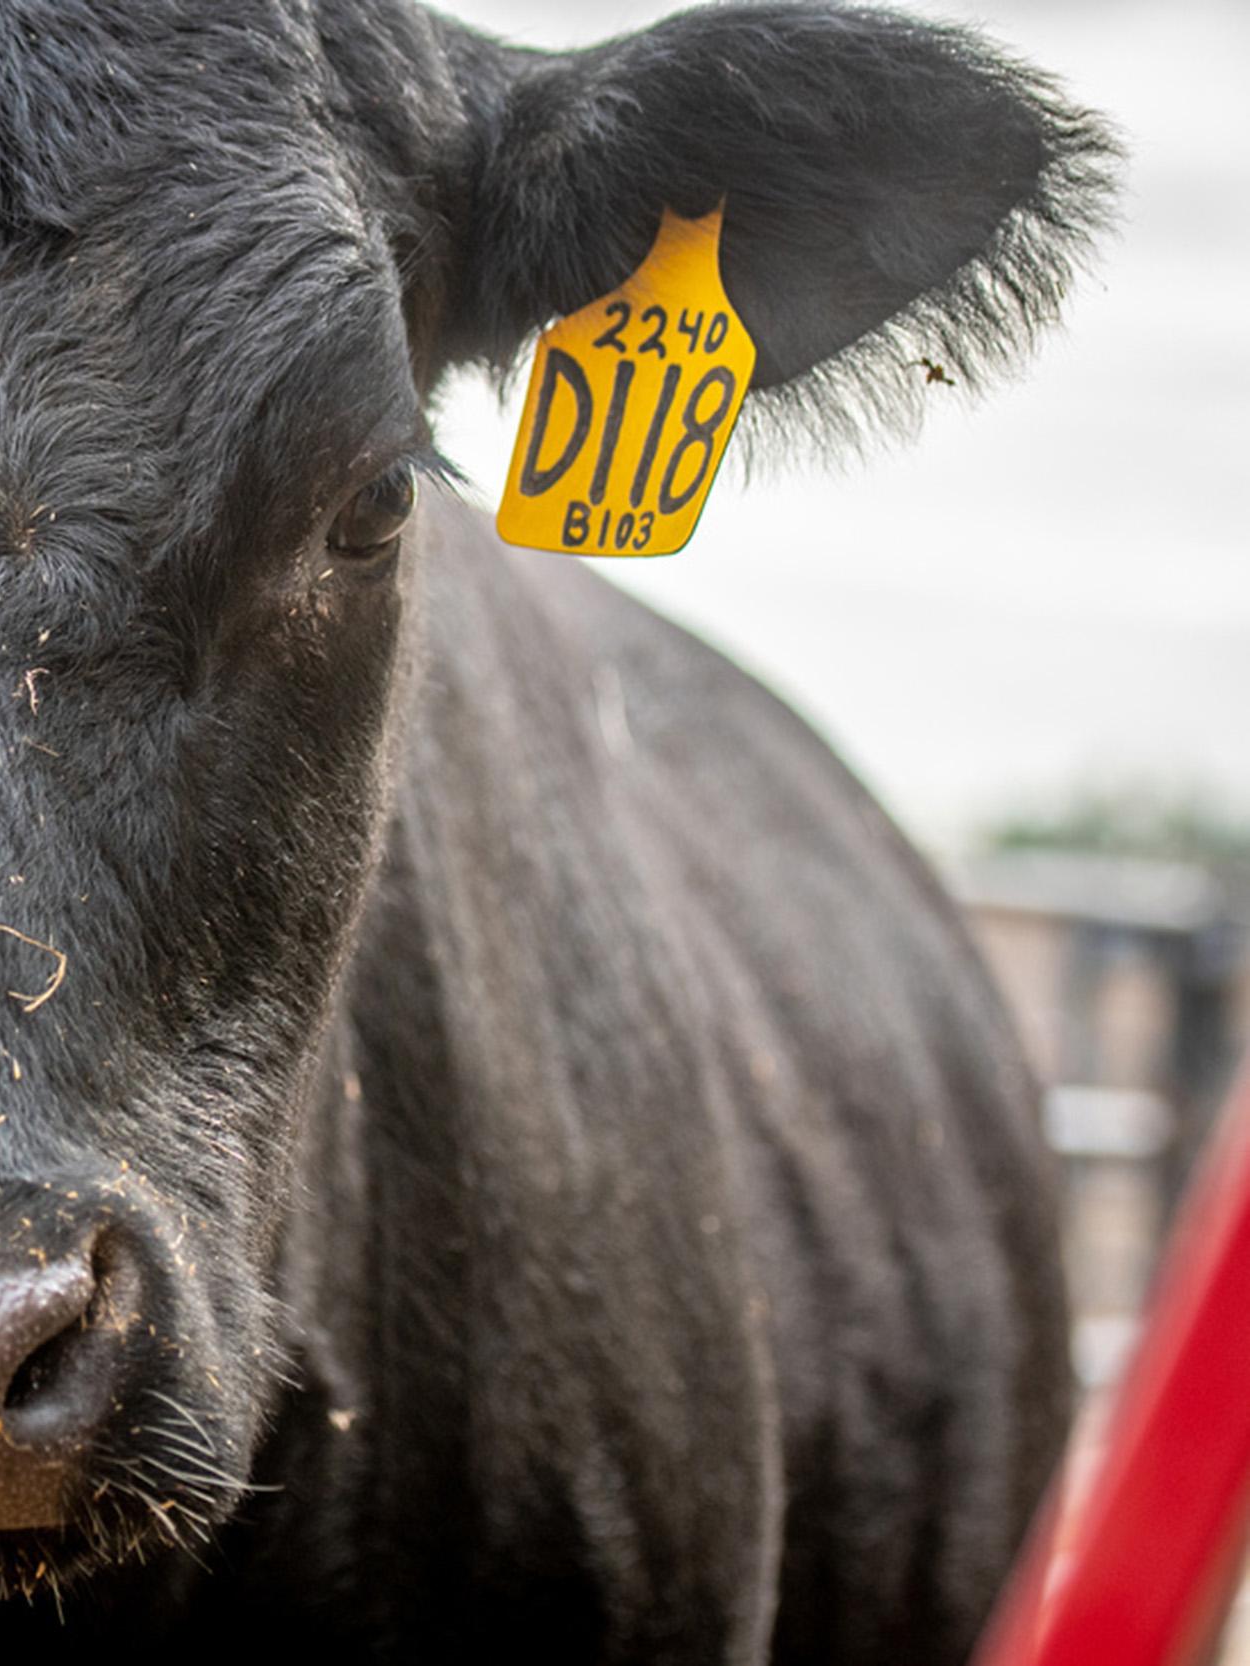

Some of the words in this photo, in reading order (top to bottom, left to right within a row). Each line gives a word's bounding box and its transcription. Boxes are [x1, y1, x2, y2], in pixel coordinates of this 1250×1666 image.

[593, 301, 729, 358] 2240
[520, 348, 735, 514] D118
[562, 501, 655, 550] B103
